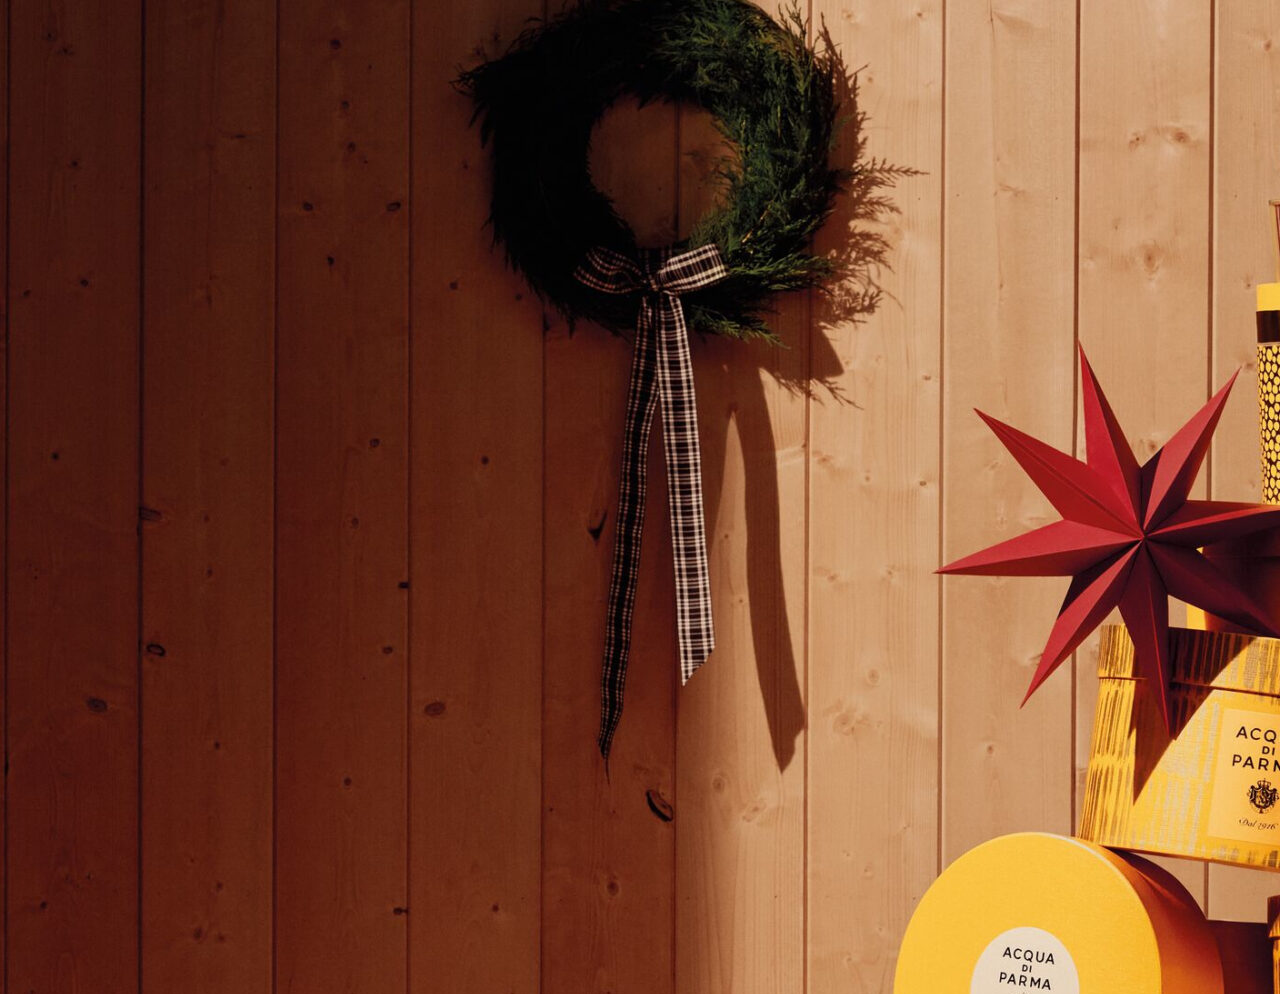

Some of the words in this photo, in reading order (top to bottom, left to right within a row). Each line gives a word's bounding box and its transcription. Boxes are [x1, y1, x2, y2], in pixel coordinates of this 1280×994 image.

[1261, 746, 1275, 756] DI
[1002, 946, 1055, 965] ACQUA
[1021, 964, 1032, 973] DI
[998, 972, 1051, 990] PARMA
